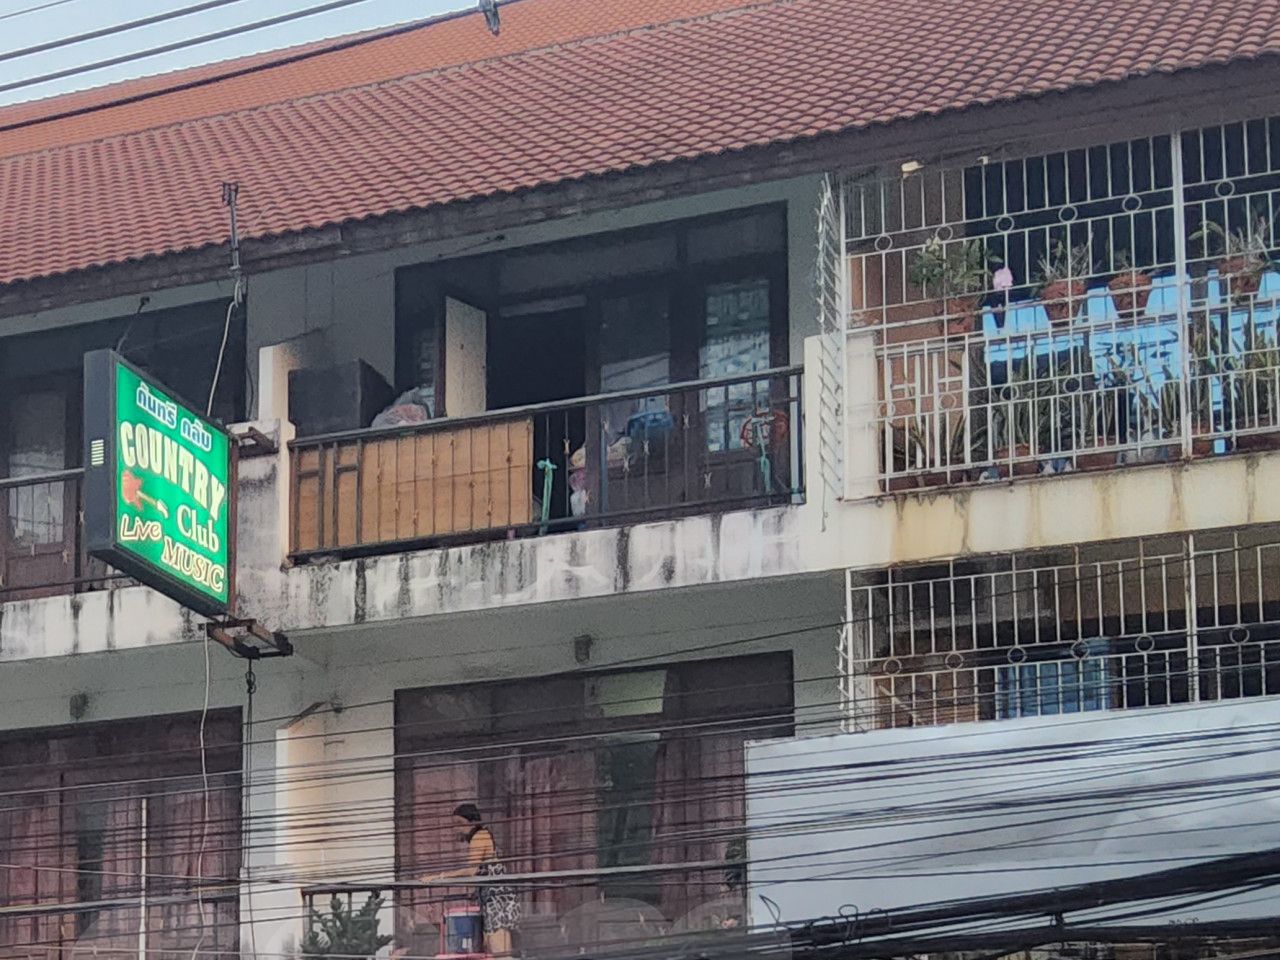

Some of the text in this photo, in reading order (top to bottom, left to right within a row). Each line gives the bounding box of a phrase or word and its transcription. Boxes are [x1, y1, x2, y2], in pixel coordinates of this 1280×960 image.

[121, 422, 225, 521] COUNTRY
[177, 504, 219, 553] Club
[161, 536, 224, 592] MUSIC
